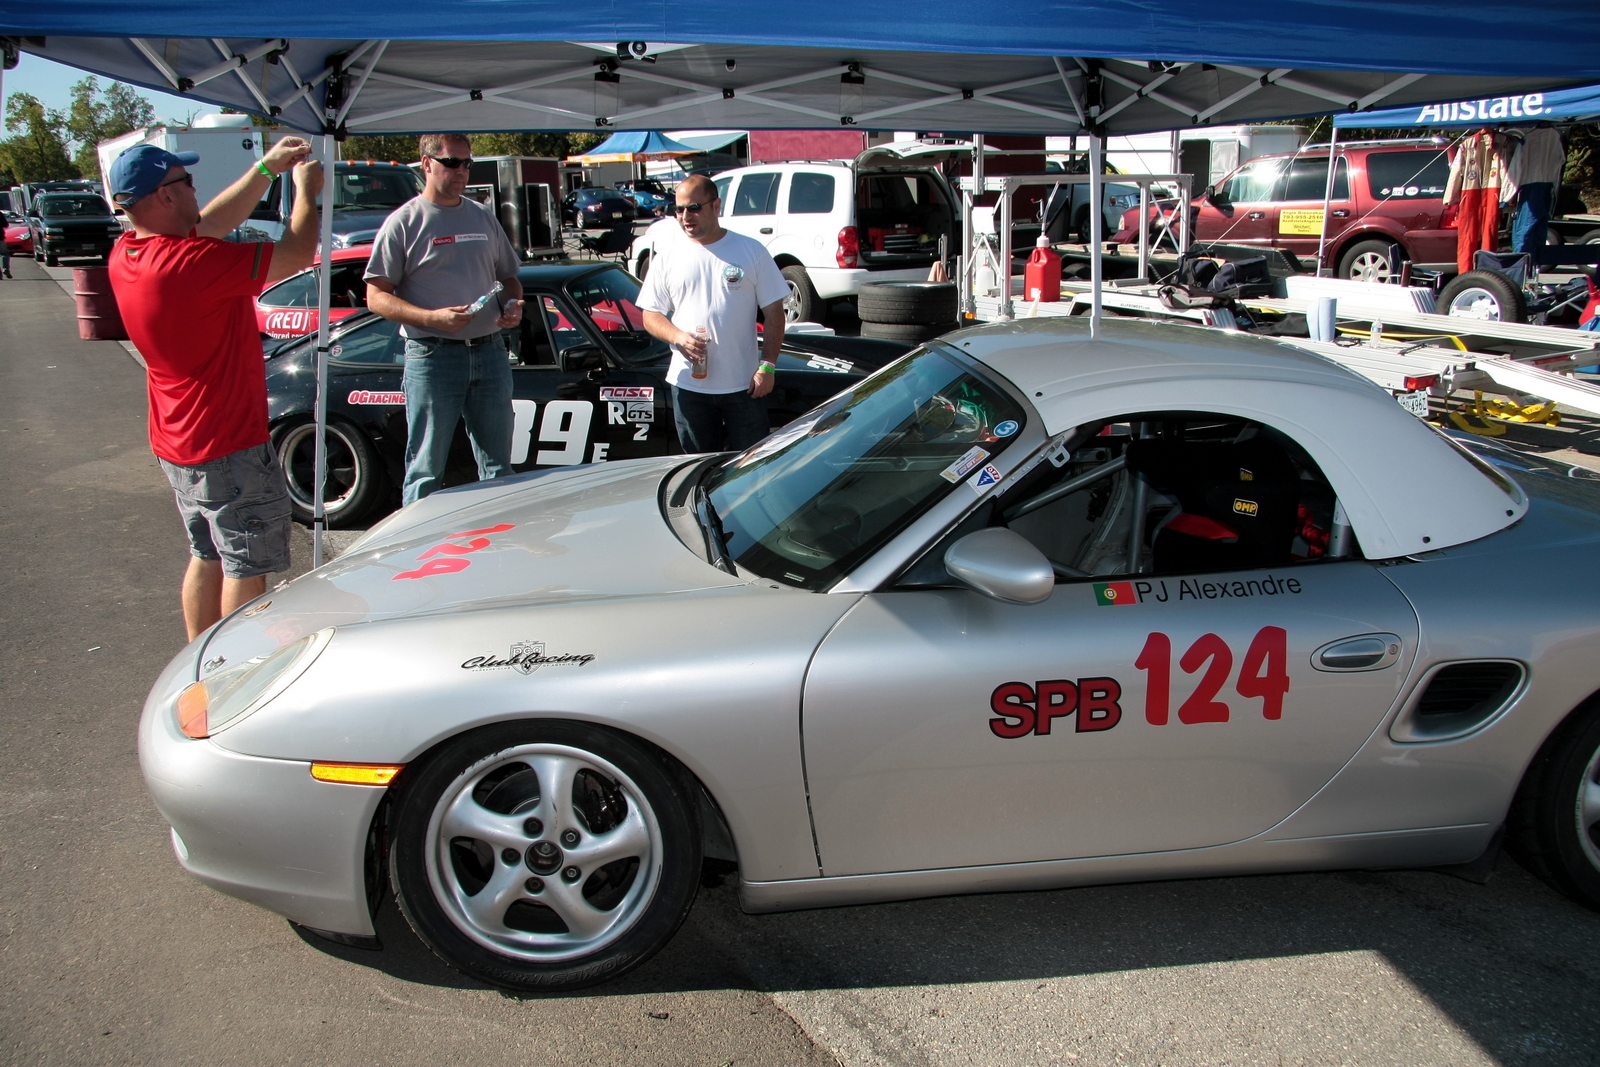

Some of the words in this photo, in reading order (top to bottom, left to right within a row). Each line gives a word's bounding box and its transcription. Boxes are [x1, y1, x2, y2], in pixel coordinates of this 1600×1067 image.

[266, 311, 309, 331] (RED)
[608, 401, 626, 425] R
[628, 410, 653, 419] GTS
[633, 423, 650, 440] 2
[996, 421, 1016, 435] 3
[1235, 501, 1257, 513] OMP
[391, 523, 517, 581] 124
[1179, 574, 1303, 601] Alexandre
[460, 652, 523, 669] Club
[519, 651, 596, 667] Racing
[1133, 625, 1290, 726] 124
[988, 676, 1123, 740] SPB
